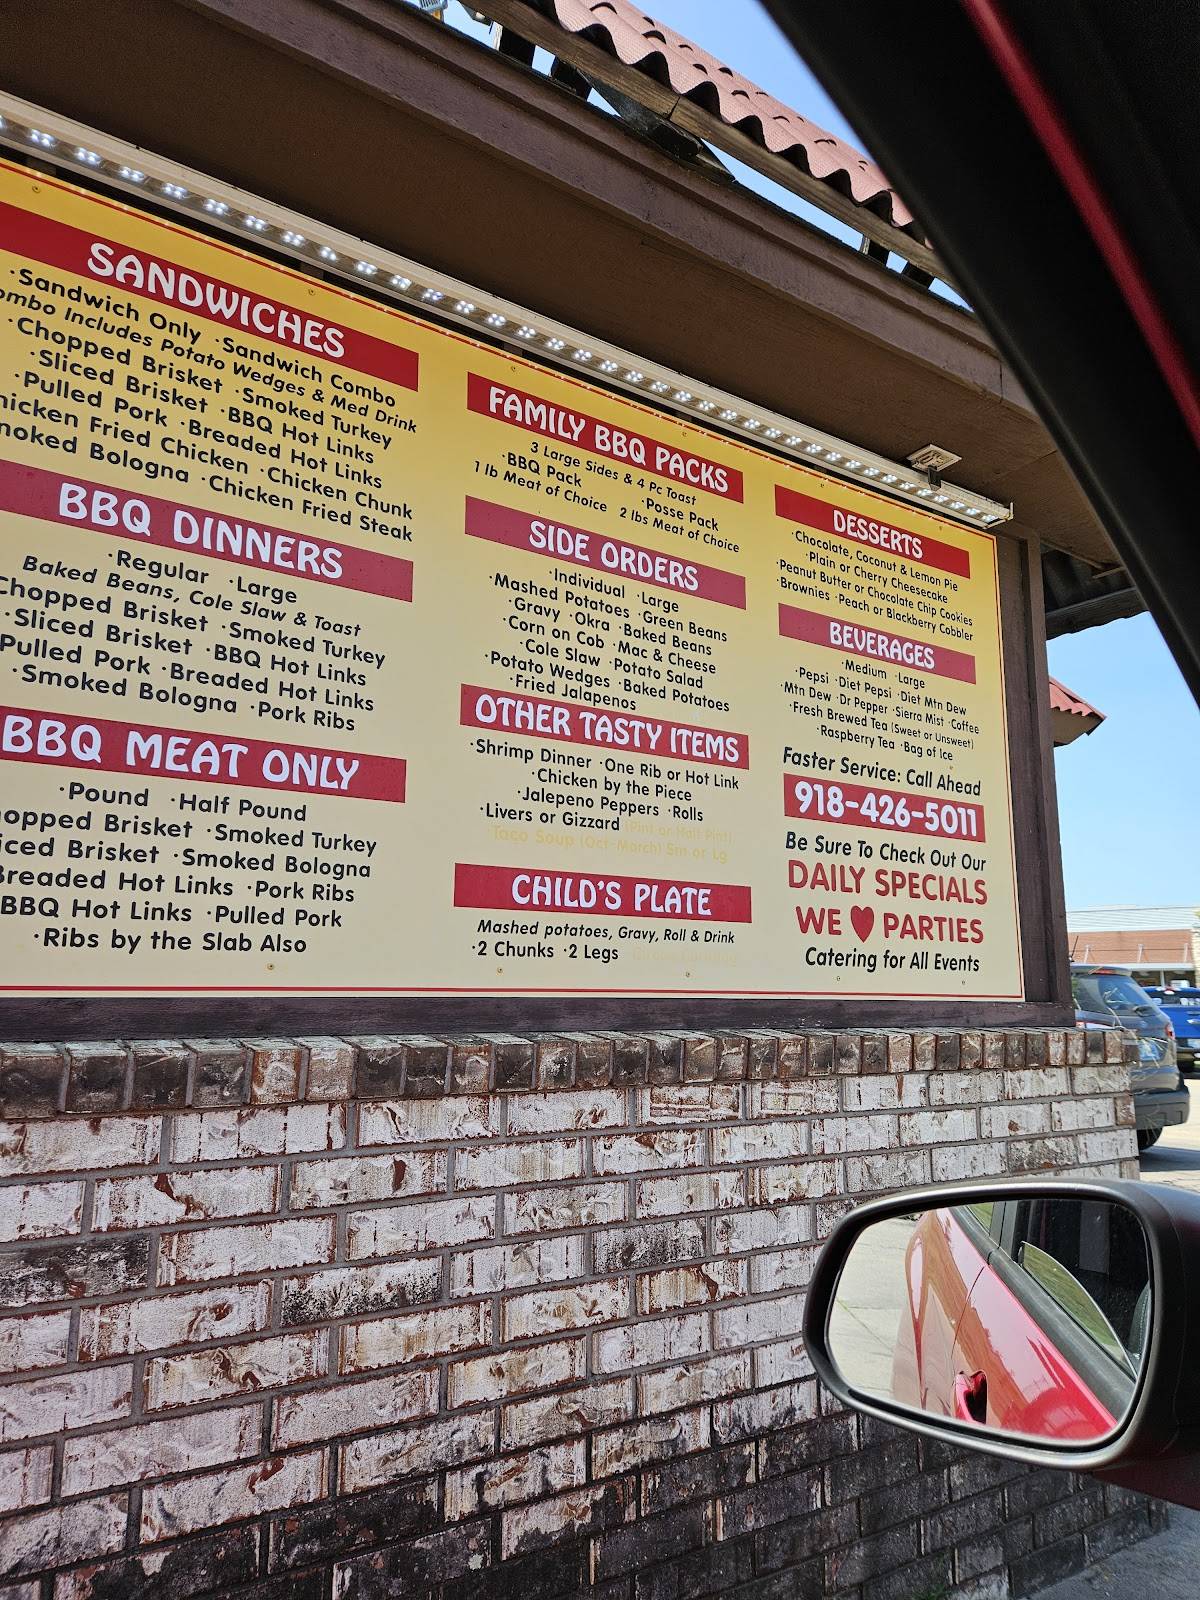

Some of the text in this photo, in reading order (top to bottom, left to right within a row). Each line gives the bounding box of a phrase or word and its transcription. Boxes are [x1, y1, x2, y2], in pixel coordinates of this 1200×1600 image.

[87, 242, 345, 358] SANDWICHES
[18, 268, 396, 407] Sandwich Only Sandwich Combo
[23, 370, 382, 489] Pulled Pork Breaded Hot Links
[489, 386, 728, 493] FAMILY BBQ PACKS
[474, 460, 607, 512] 1 lb Meat of Choice
[507, 451, 582, 488] BBQ Pack
[530, 441, 697, 506] 3 Large Sides & 4 Pc Toast
[59, 482, 343, 579] BBQ DINNERS
[646, 497, 719, 532] Posse Pack
[833, 509, 923, 559] DESSERTS
[116, 549, 297, 605] Regular Large
[529, 520, 699, 591] SIDE ORDERS
[795, 530, 958, 592] Chocolate, Coconut & Lemon Pie
[22, 555, 361, 637] Baked Beans, Cole Slaw & Toast
[494, 572, 727, 642] Mashed Potatoes Green Beans
[554, 567, 679, 614] Individual Large
[779, 558, 973, 626] Peanut Butter or Chocolate Chip Cookies
[780, 576, 974, 641] Brownies Peach or Blackberry Cobbler
[14, 608, 366, 687] Sliced Brisket BBQ Hot Links
[508, 615, 716, 674] Corn on Cob Mac & Cheese
[829, 621, 935, 670] BEVERAGES
[21, 663, 355, 731] Smoked Bologna Pork Ribs
[515, 673, 636, 711] Fried Jalapenos
[799, 666, 967, 716] Pepsi Diet Pepsi Diet Mtn Dew
[845, 659, 925, 690] Medium Large
[2, 714, 360, 790] BBQ MEAT ONLY
[475, 693, 740, 763] OTHER TASTY ITEMS
[820, 724, 953, 761] Raspberry Tea Bag of Ice
[537, 767, 692, 802] Chicken by the Piece
[783, 746, 981, 796] Faster Service: Call Ahead
[68, 781, 307, 822] Pound Half Pound
[486, 802, 533, 822] Livers
[539, 812, 557, 824] or
[562, 811, 620, 831] Gizzard
[522, 786, 704, 822] Jalepeno Peppers Rolls
[794, 780, 977, 837] 918-426-5011
[785, 831, 987, 871] Be Sure To Check Out Our
[511, 874, 712, 916] CHILD'S PLATE
[788, 859, 988, 905] DAILY SPECIALS
[43, 926, 307, 955] Ribs by the Slab Also
[477, 919, 735, 944] Mashed potatoes, Gravy, Roll & Drink
[795, 905, 984, 944] WE PARTIES
[477, 940, 488, 956] 2
[494, 940, 554, 958] Chunks
[568, 943, 578, 959] 2
[584, 944, 619, 964] Legs
[805, 946, 980, 973] Catering for All Events
